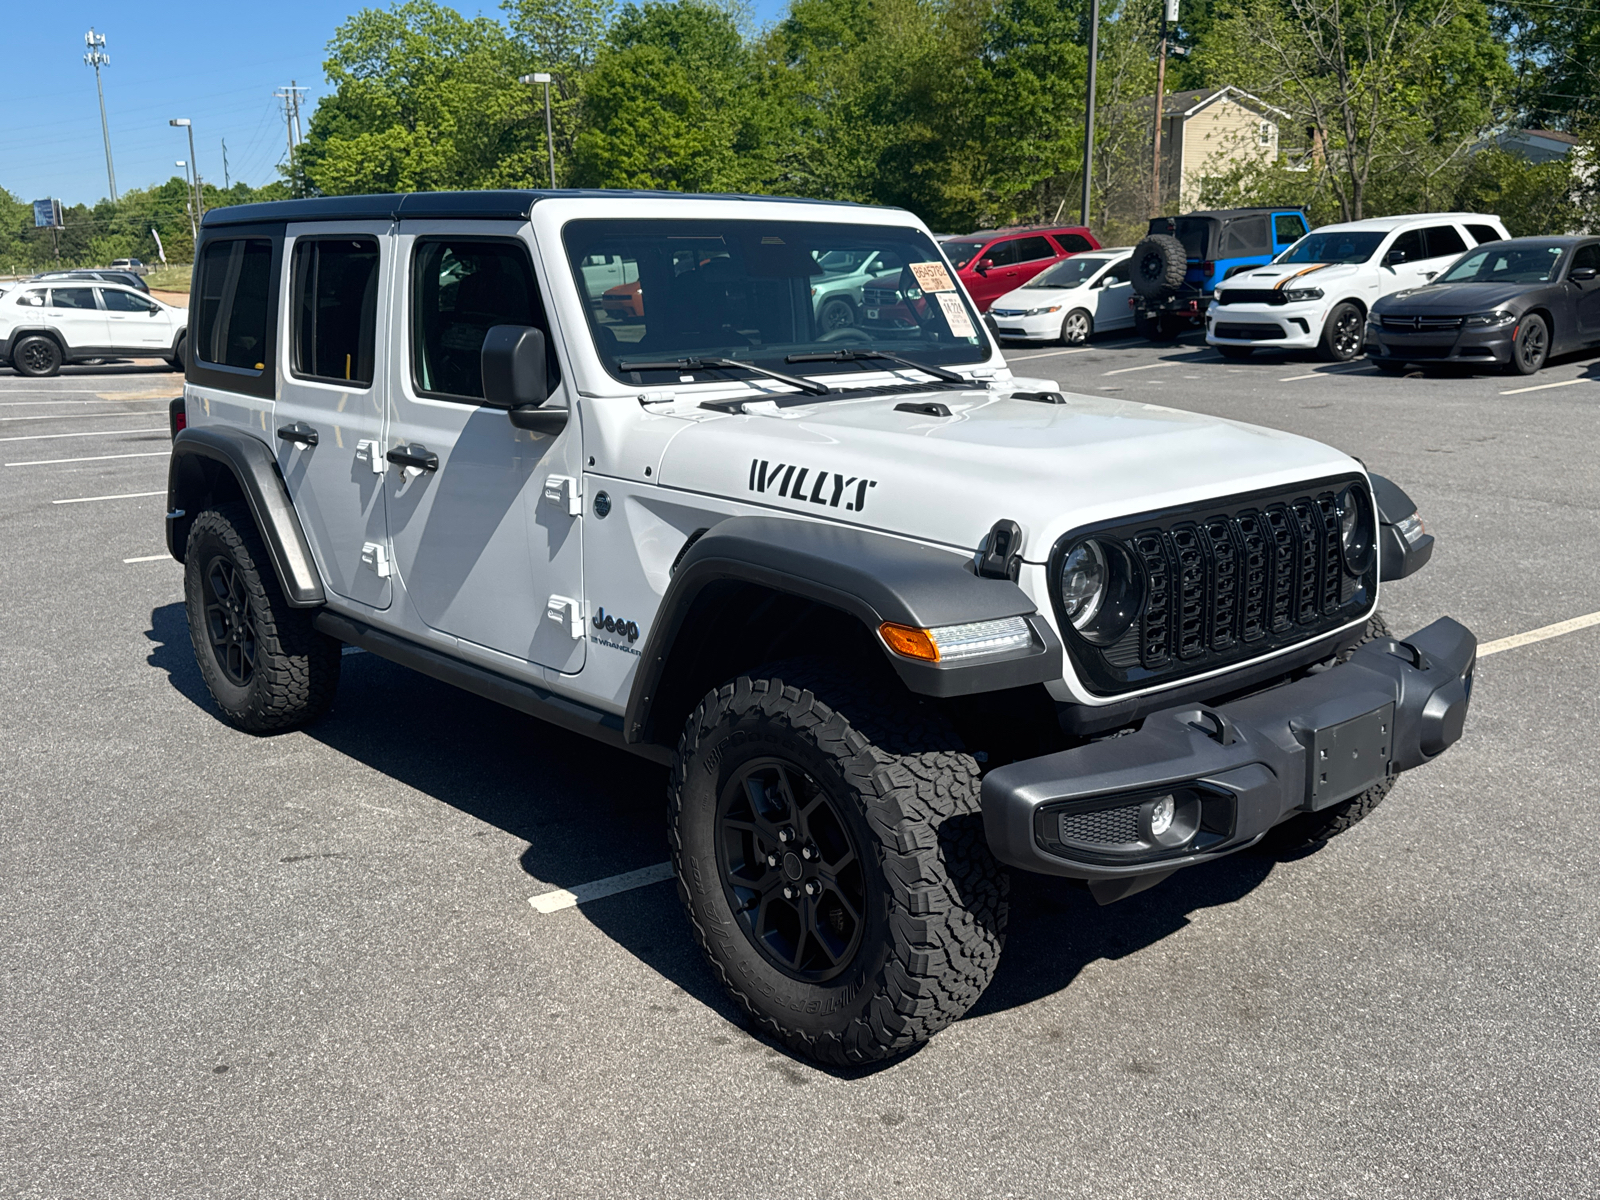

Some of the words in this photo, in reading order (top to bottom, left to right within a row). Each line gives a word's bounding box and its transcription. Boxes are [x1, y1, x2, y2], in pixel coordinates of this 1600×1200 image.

[749, 459, 877, 512] WILLYS
[592, 606, 640, 643] Jeep
[599, 638, 641, 656] WRANGLER
